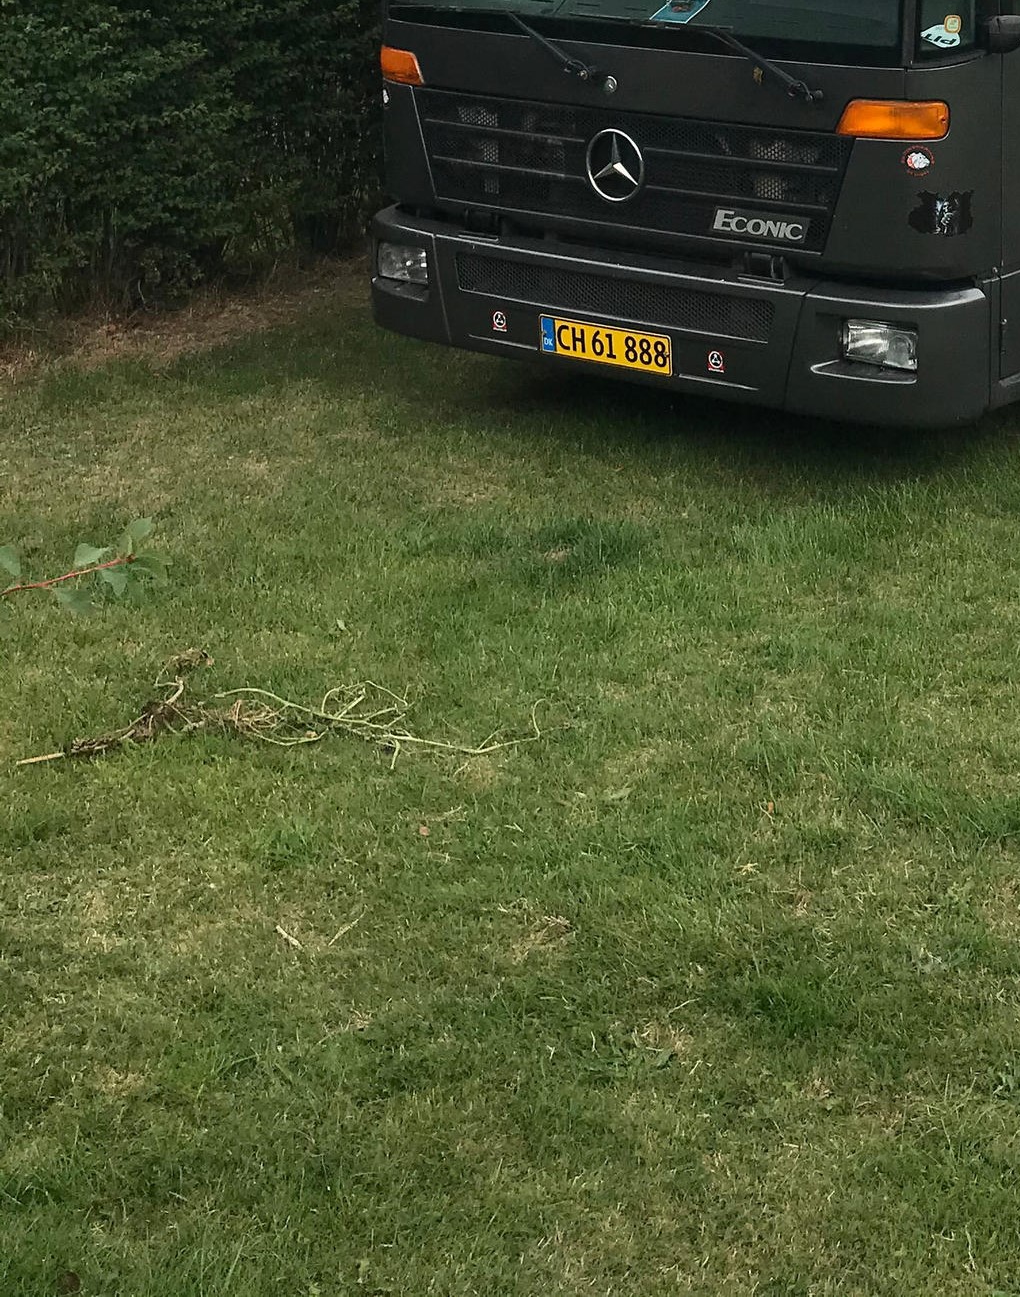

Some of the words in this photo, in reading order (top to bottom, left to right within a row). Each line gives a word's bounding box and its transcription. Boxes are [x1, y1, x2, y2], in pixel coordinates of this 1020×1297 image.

[543, 337, 554, 347] DK
[556, 324, 586, 353] CH
[591, 330, 617, 359] 61
[624, 335, 668, 368] 888
